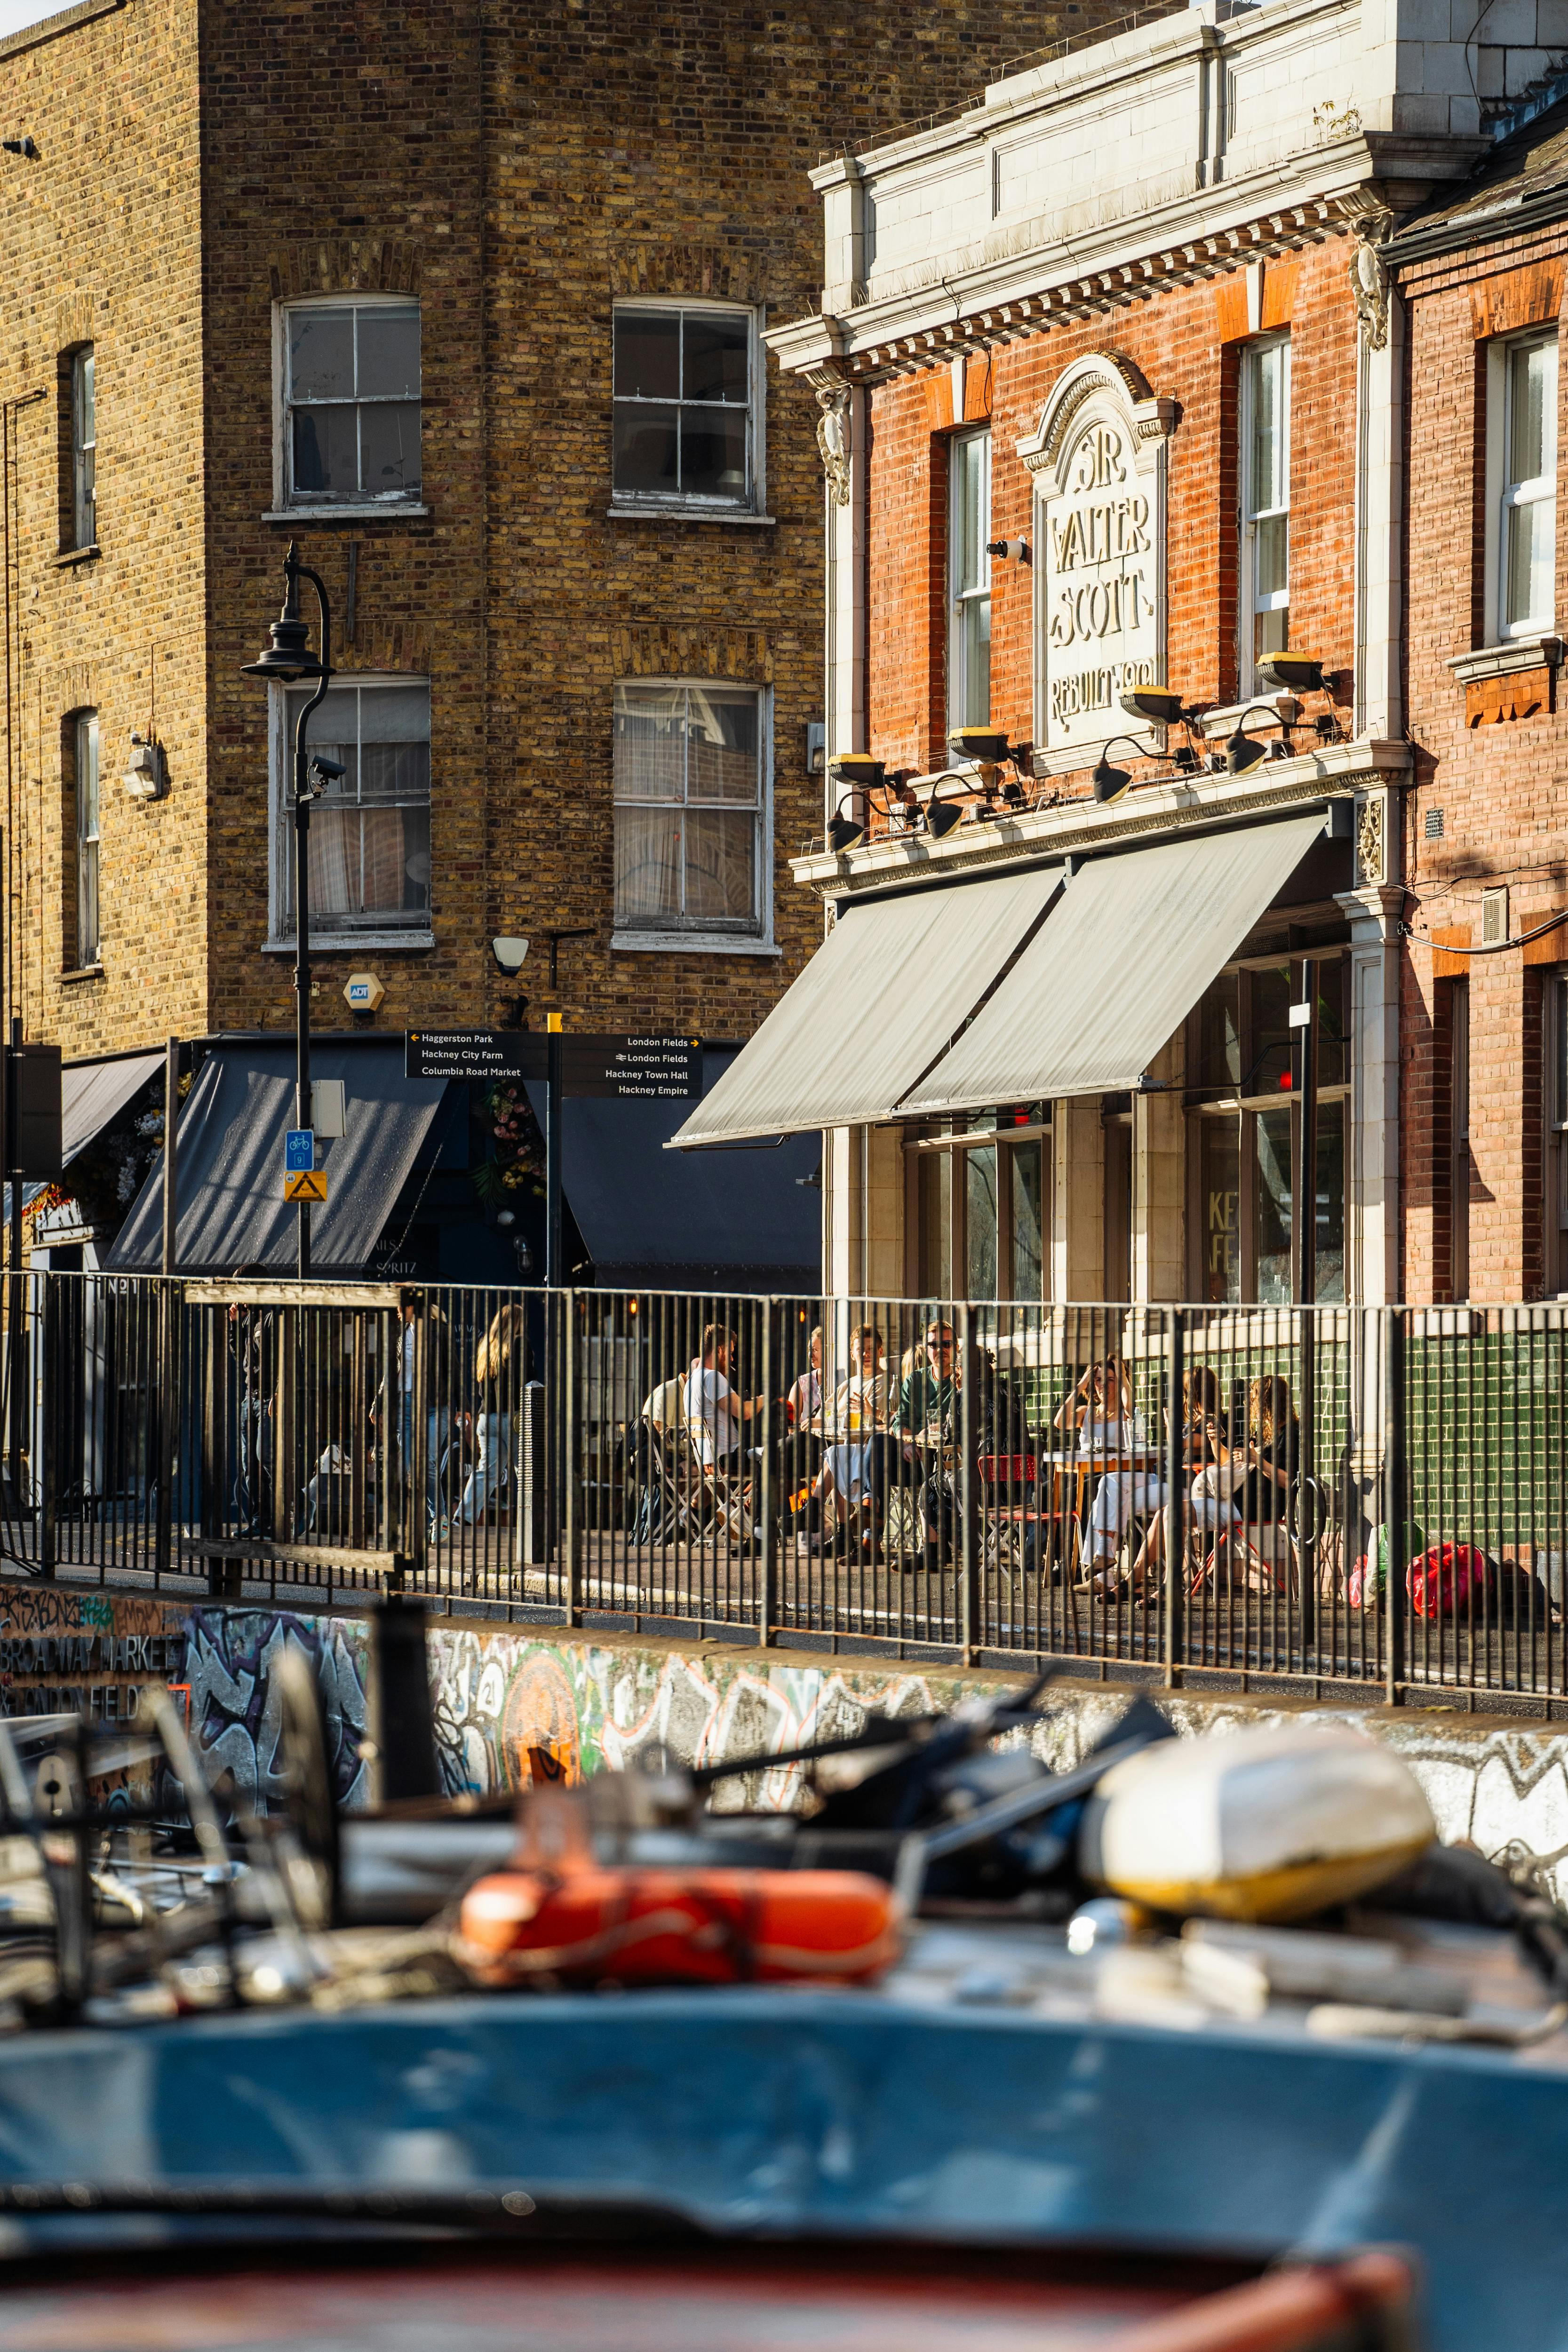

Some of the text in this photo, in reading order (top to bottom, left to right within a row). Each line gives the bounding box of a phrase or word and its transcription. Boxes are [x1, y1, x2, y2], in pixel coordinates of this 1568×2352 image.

[1073, 428, 1126, 493] SIR
[1046, 494, 1151, 573] WALTER
[1050, 568, 1148, 648] SCOTT
[1051, 668, 1112, 733] REBUILT
[351, 987, 368, 997] ADT
[422, 1034, 472, 1043] Haggerston
[628, 1038, 660, 1046] London
[422, 1050, 459, 1060] Hackney
[462, 1051, 479, 1060] City
[628, 1054, 660, 1062] London
[605, 1070, 643, 1080] Hackney
[645, 1071, 668, 1079] Town
[619, 1086, 688, 1096] Hackney Empire
[377, 1262, 416, 1274] SPRITZ
[0, 1635, 182, 1672] BROADWAY MARKET
